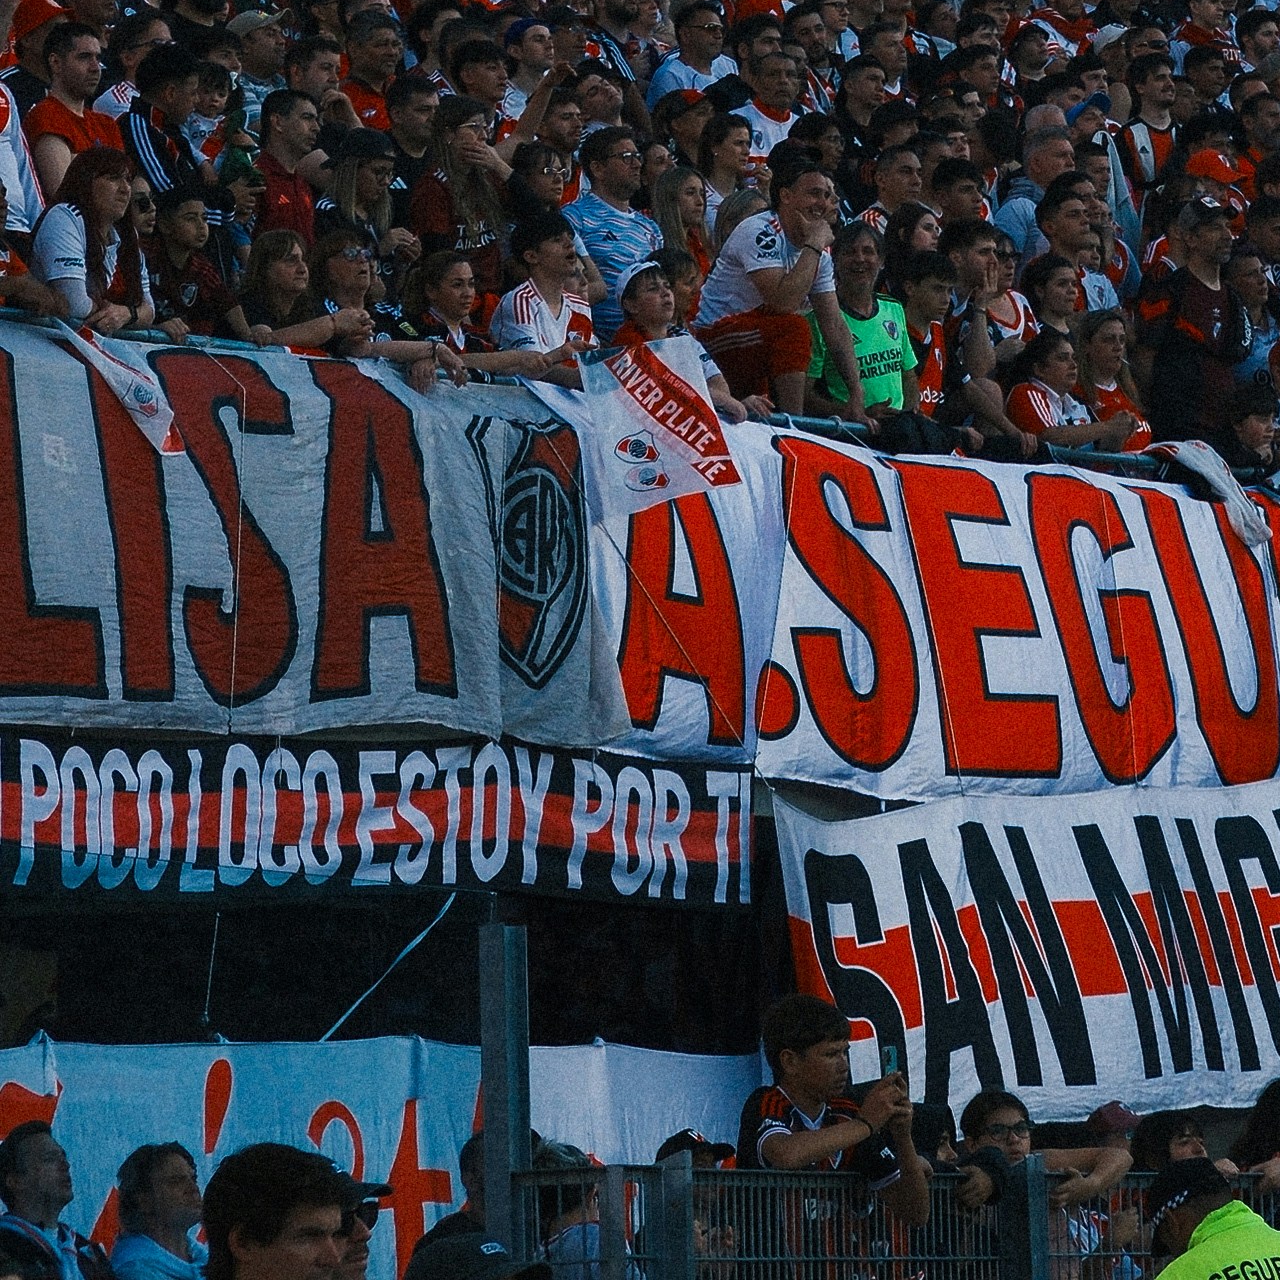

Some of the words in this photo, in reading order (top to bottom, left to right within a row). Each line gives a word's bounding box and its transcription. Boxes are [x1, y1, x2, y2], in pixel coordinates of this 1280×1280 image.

[611, 352, 664, 411] RIVER
[655, 398, 717, 453] PLATE
[859, 361, 903, 381] AIRLINE
[12, 739, 176, 892] POCO
[178, 744, 346, 894] LOCO
[350, 745, 556, 887] ESTOY
[567, 757, 695, 900] POR
[802, 836, 1097, 1107] SAN
